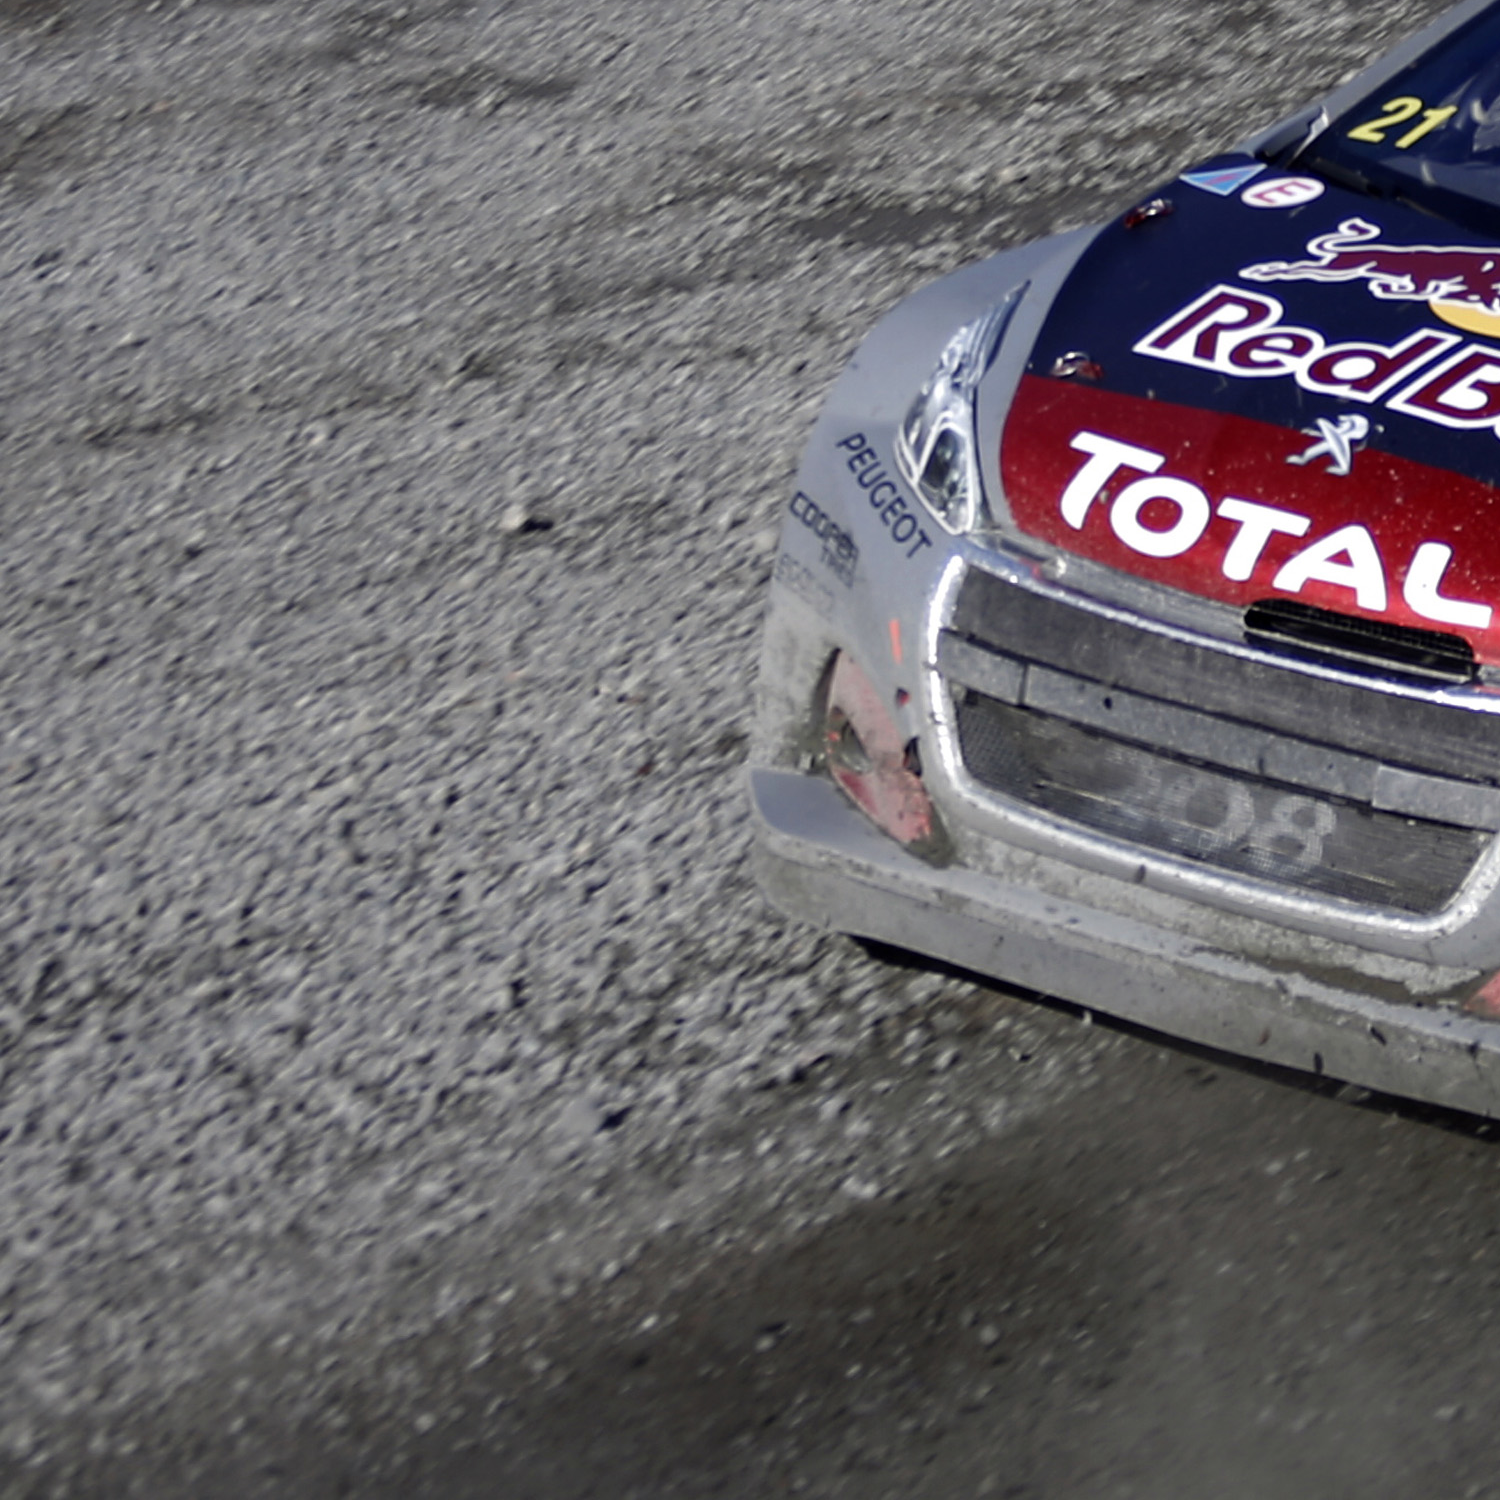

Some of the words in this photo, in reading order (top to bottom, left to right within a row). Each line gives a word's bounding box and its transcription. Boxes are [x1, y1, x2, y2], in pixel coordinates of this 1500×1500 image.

[1347, 96, 1459, 149] 21
[1133, 284, 1464, 403] Red
[836, 432, 932, 558] PEUGEOT
[1059, 430, 1493, 630] TOTAL
